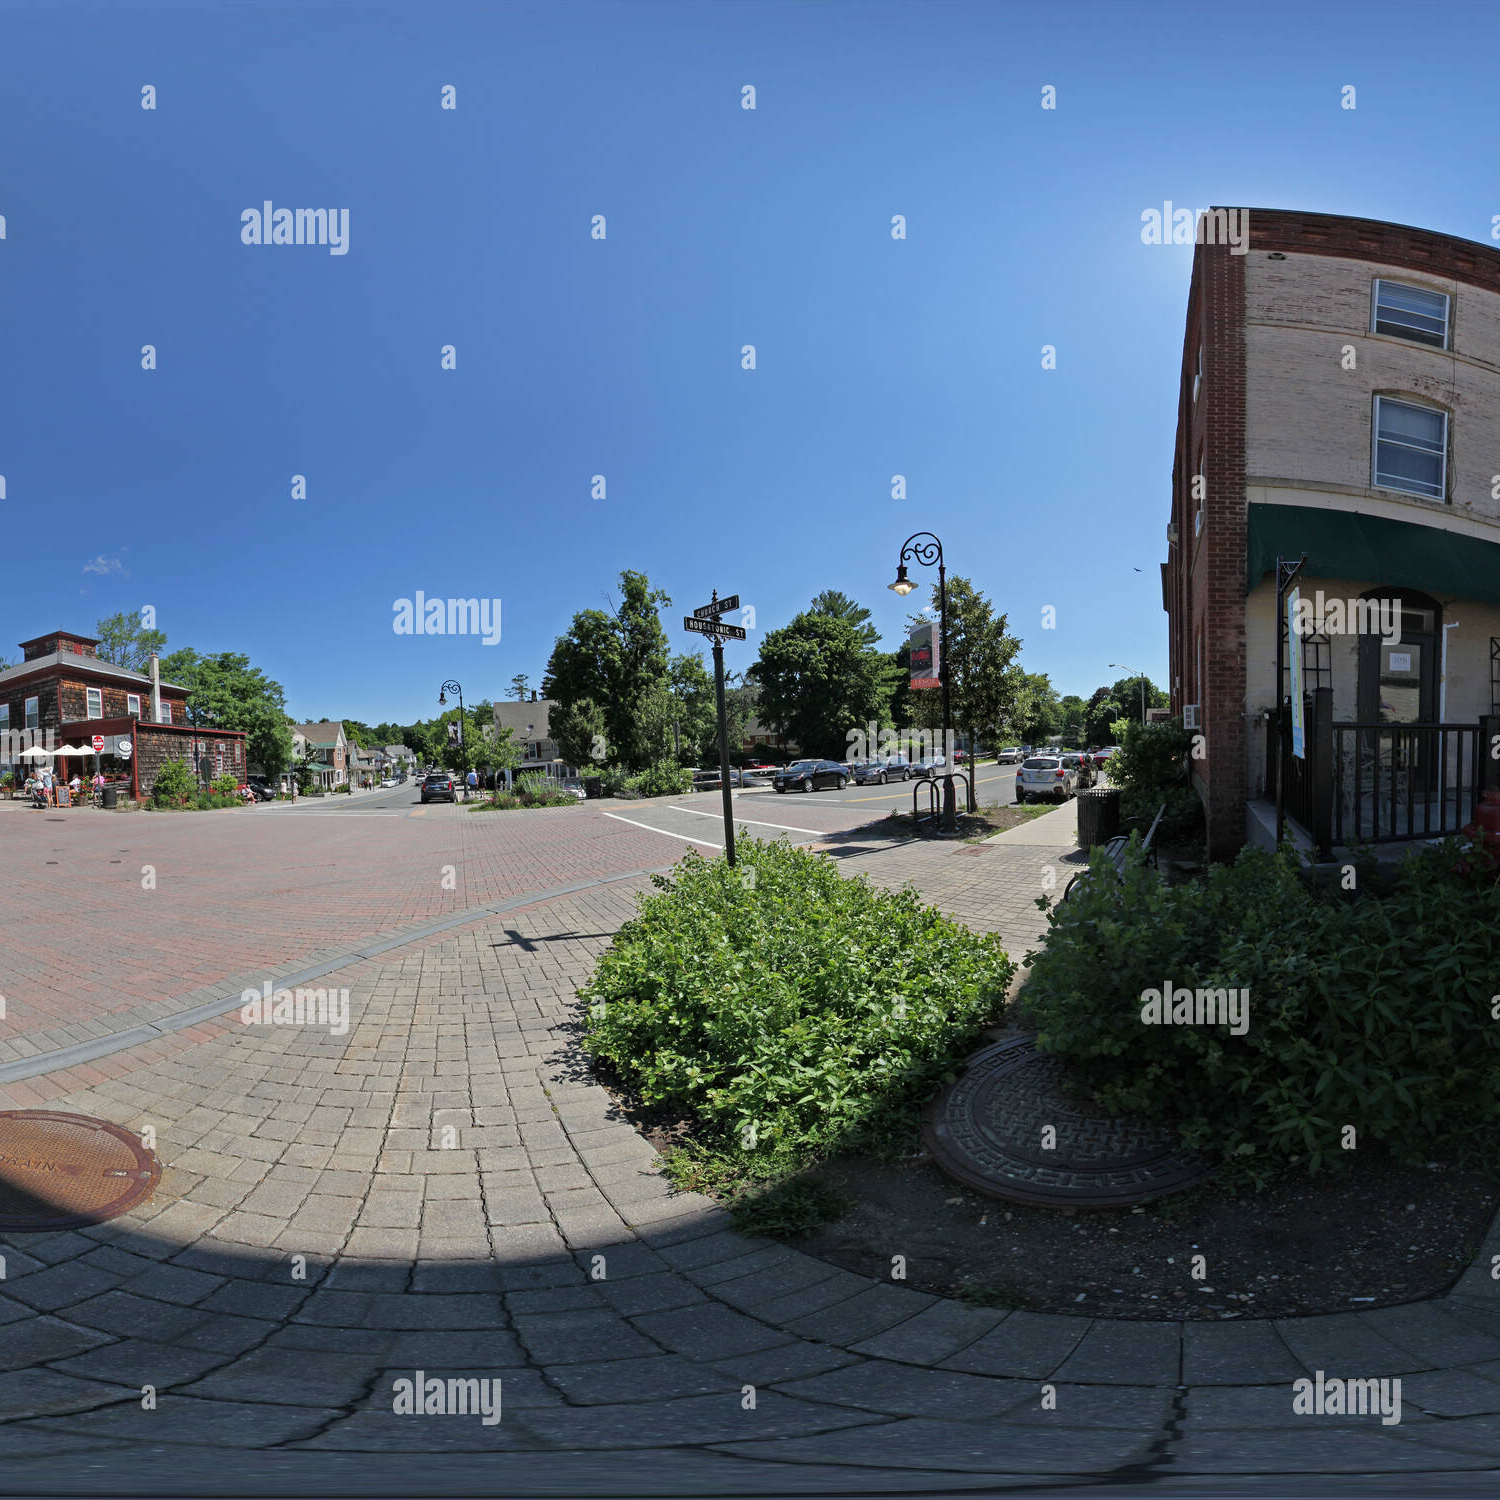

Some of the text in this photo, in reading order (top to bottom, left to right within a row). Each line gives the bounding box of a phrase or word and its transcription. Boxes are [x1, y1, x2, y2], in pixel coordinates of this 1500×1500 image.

[697, 599, 733, 618] CHURCH ST
[689, 619, 744, 638] HOUSATONIC ST
